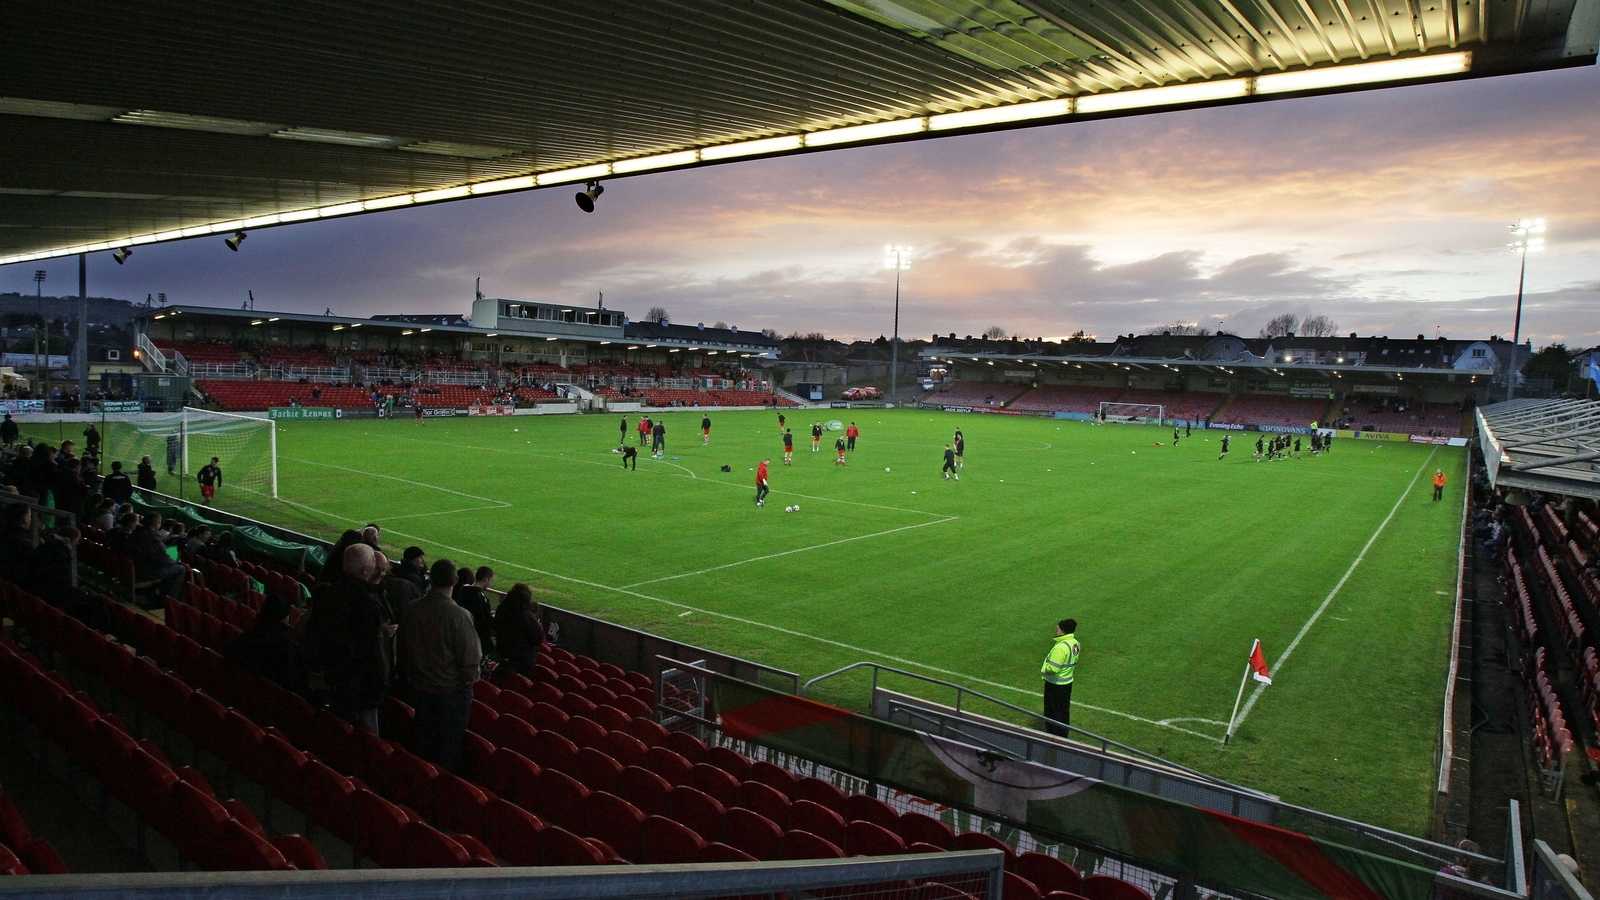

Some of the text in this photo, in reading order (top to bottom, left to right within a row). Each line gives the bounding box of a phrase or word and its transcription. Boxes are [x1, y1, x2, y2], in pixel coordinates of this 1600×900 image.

[271, 409, 299, 419] Jackie
[302, 409, 332, 418] Lennox
[1209, 422, 1230, 430] Evening
